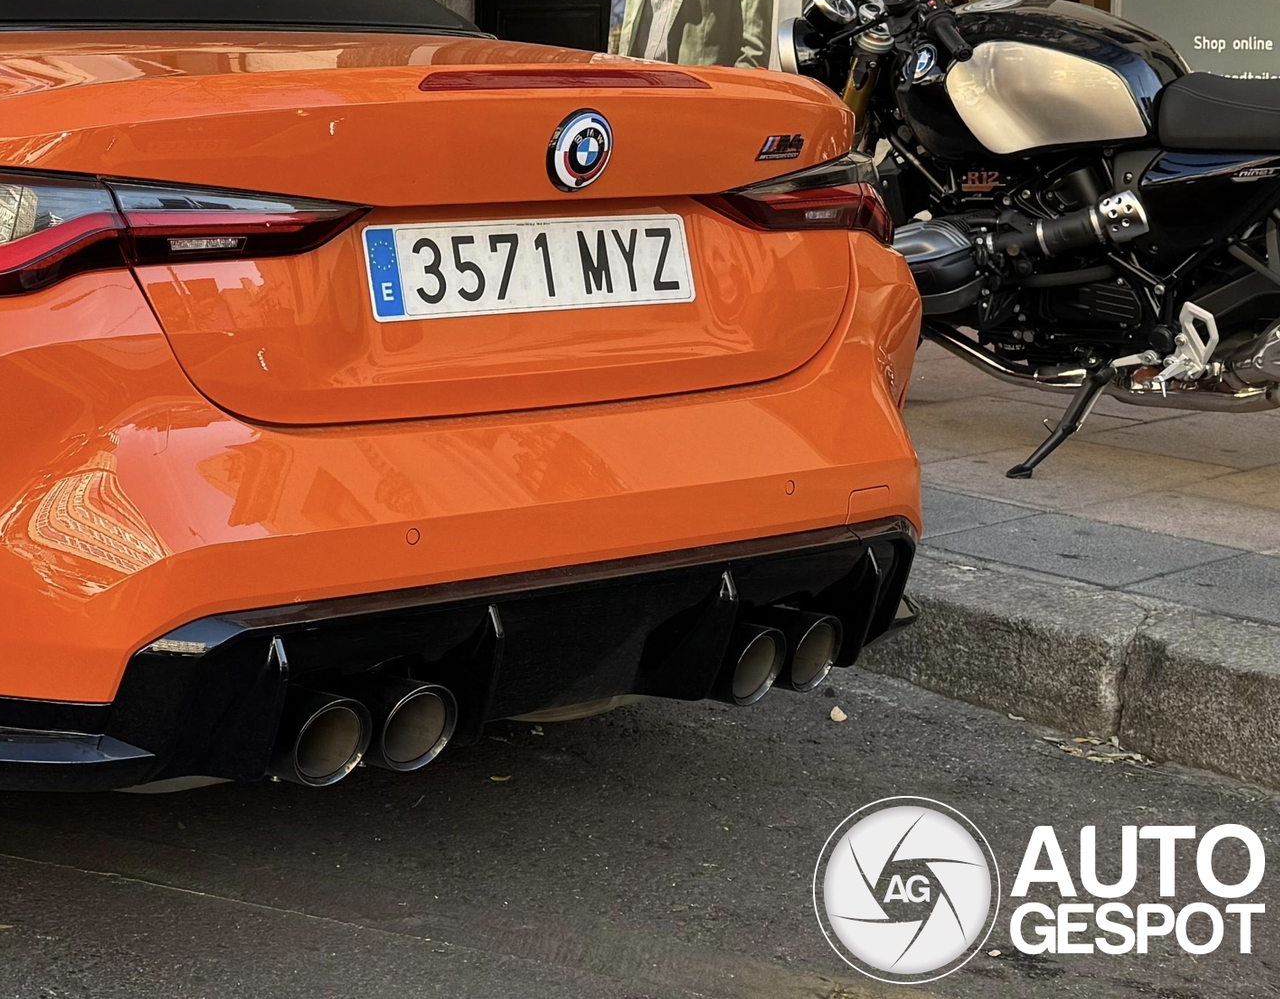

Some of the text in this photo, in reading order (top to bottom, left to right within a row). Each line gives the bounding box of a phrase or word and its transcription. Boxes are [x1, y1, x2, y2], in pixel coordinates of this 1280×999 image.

[1193, 35, 1273, 53] Shop online
[574, 128, 604, 145] BMW
[967, 171, 999, 185] R12
[412, 228, 680, 304] 3571 MYZ
[381, 282, 394, 301] E
